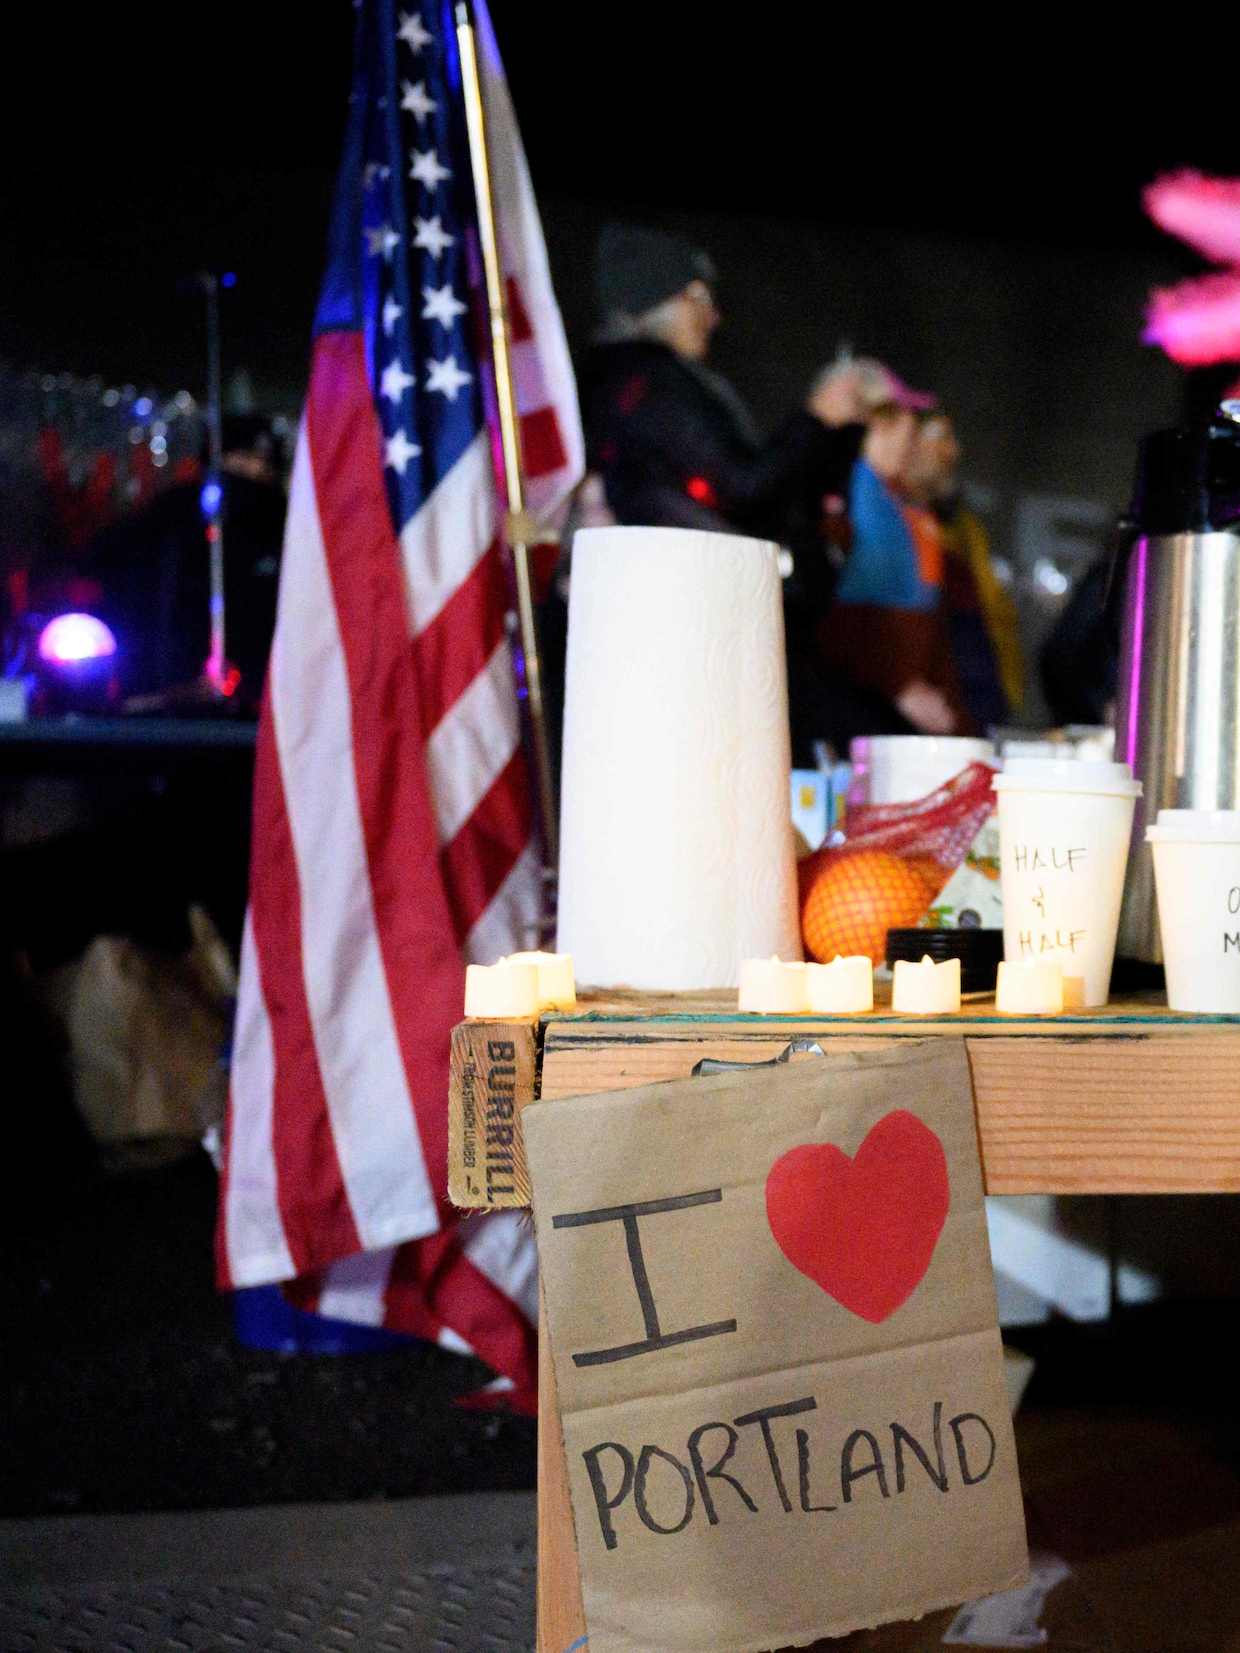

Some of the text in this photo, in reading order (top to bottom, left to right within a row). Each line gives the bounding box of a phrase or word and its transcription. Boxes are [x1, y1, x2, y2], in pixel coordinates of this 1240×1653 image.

[1014, 845, 1087, 872] HALF
[1018, 929, 1087, 955] HALF
[463, 1129, 477, 1168] LUMBER
[486, 1040, 515, 1204] BURRILL
[552, 1188, 737, 1368] I
[580, 1396, 997, 1551] PORTLAND
